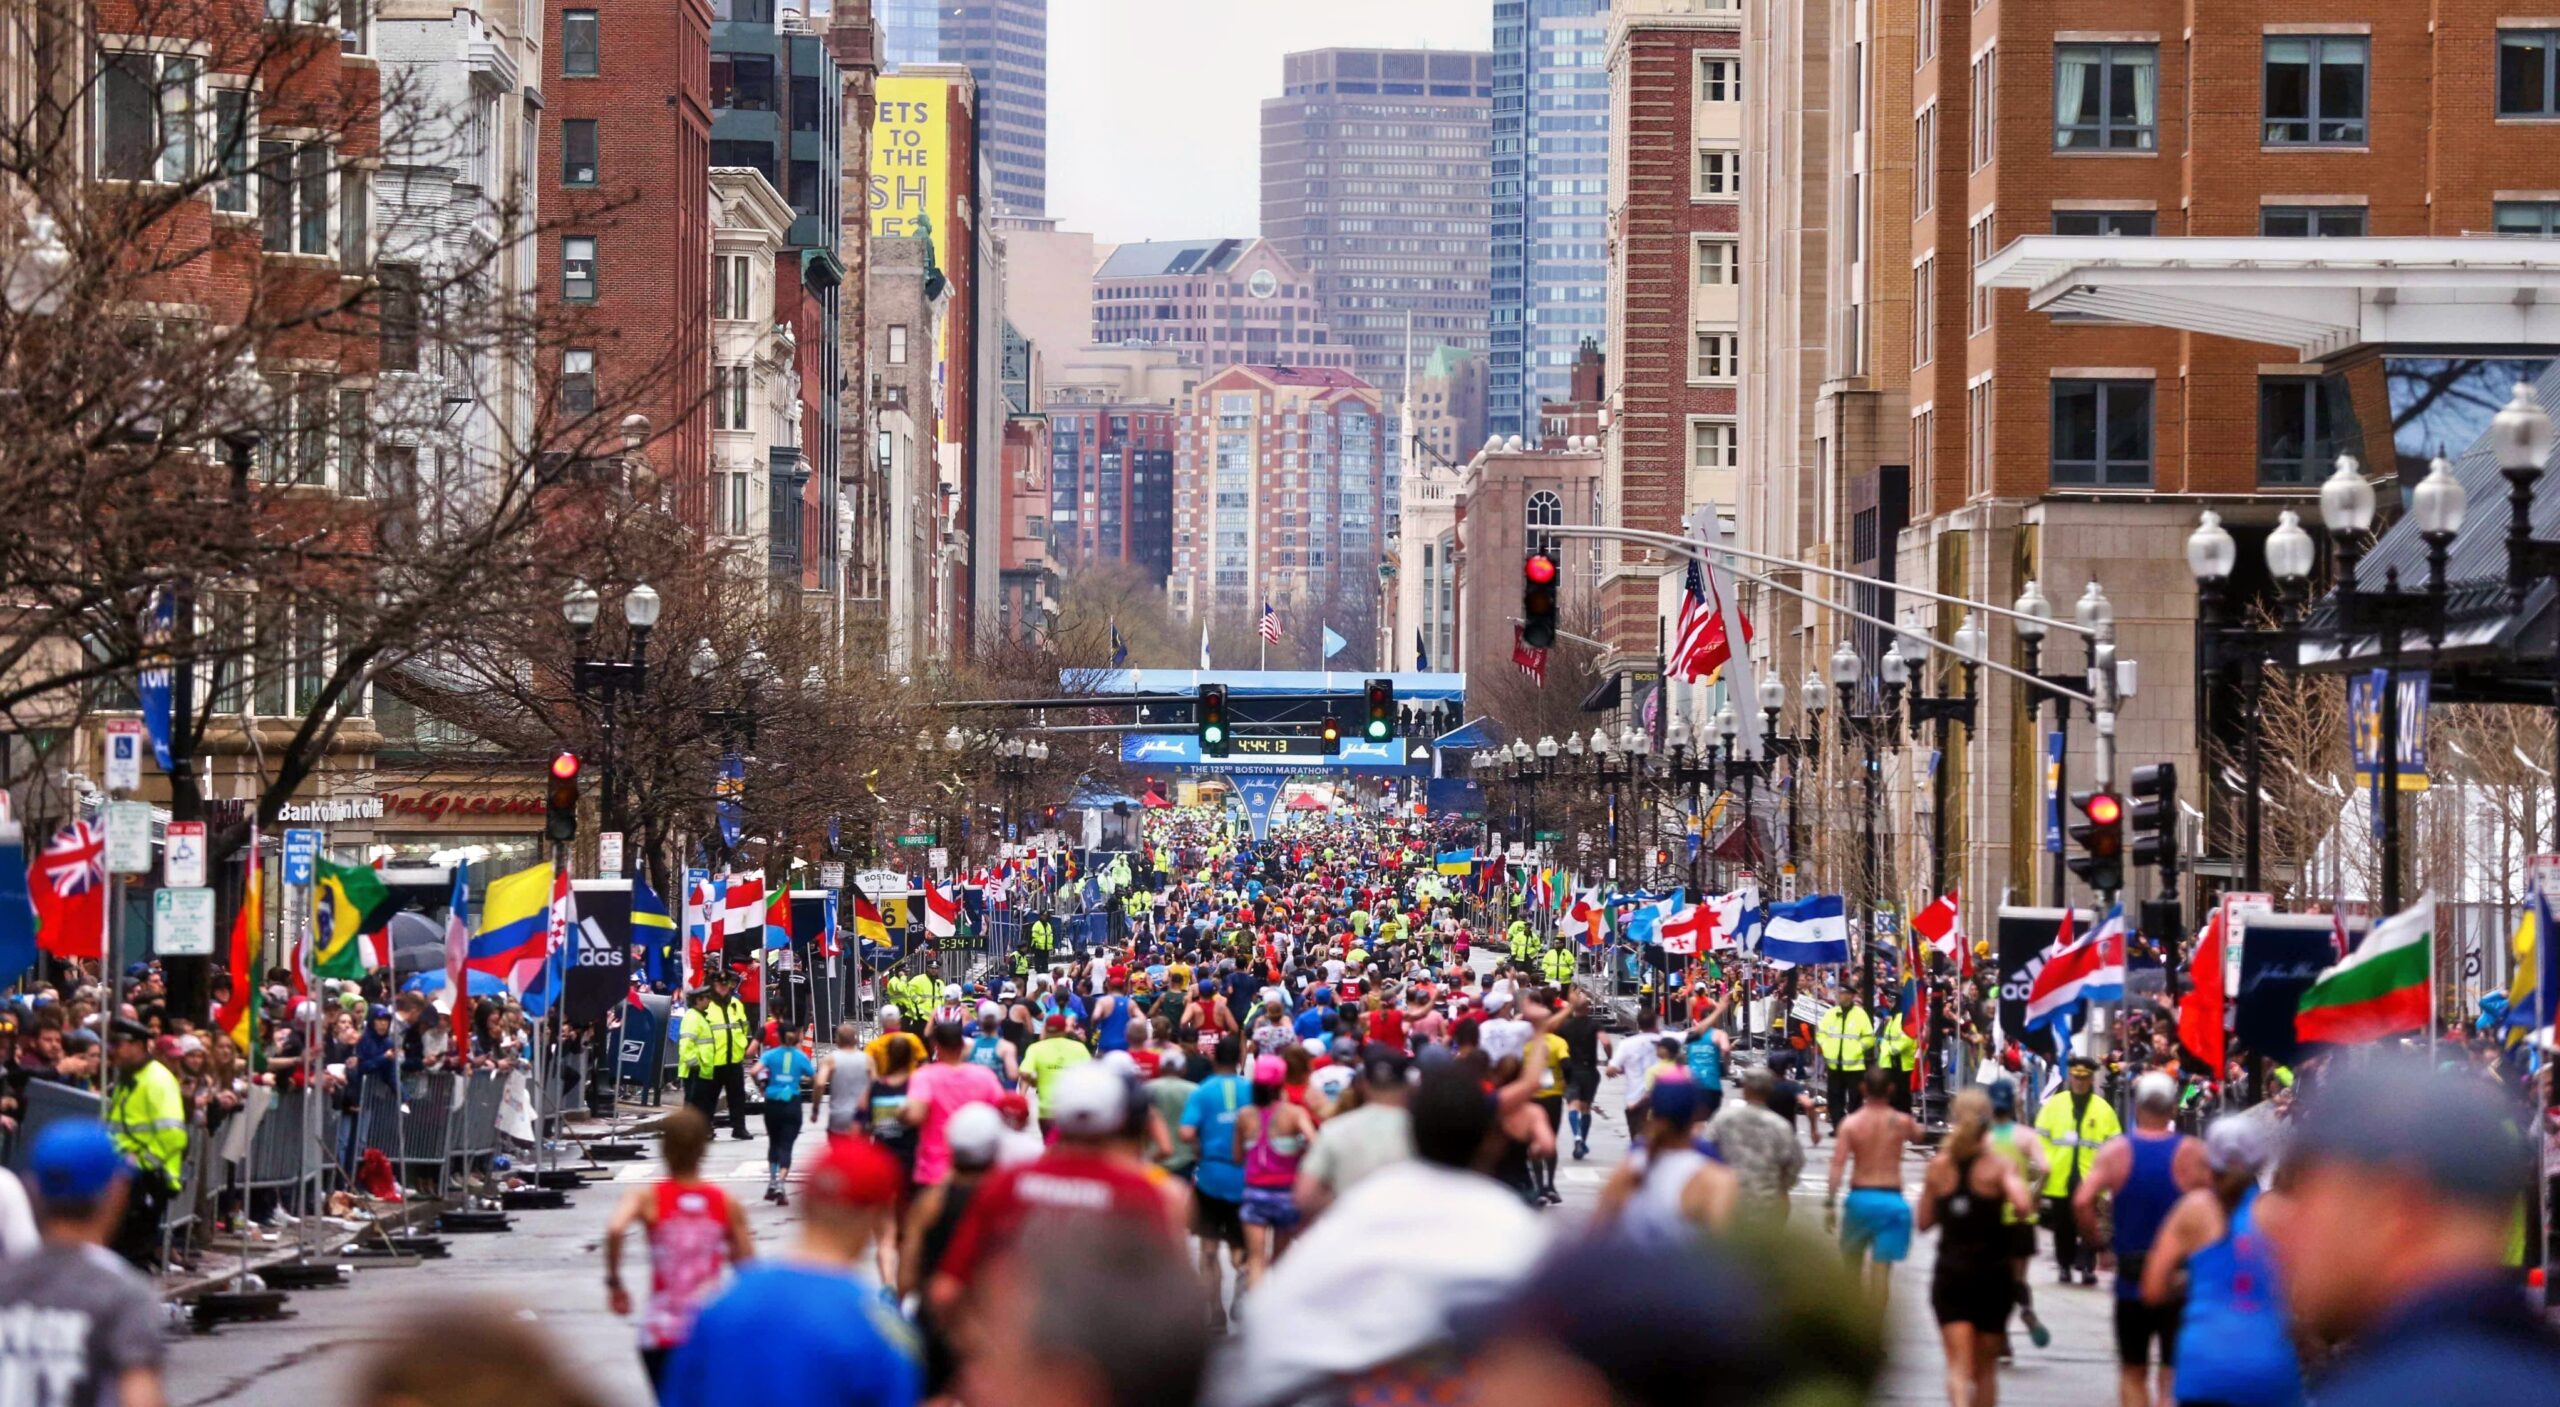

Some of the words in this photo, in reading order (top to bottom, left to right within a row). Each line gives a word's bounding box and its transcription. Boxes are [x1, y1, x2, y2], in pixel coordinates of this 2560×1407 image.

[890, 130, 921, 147] TO
[883, 150, 927, 166] THE
[1191, 765, 1208, 773] THE
[1210, 765, 1232, 773] 123RD
[864, 873, 898, 883] BOSTON
